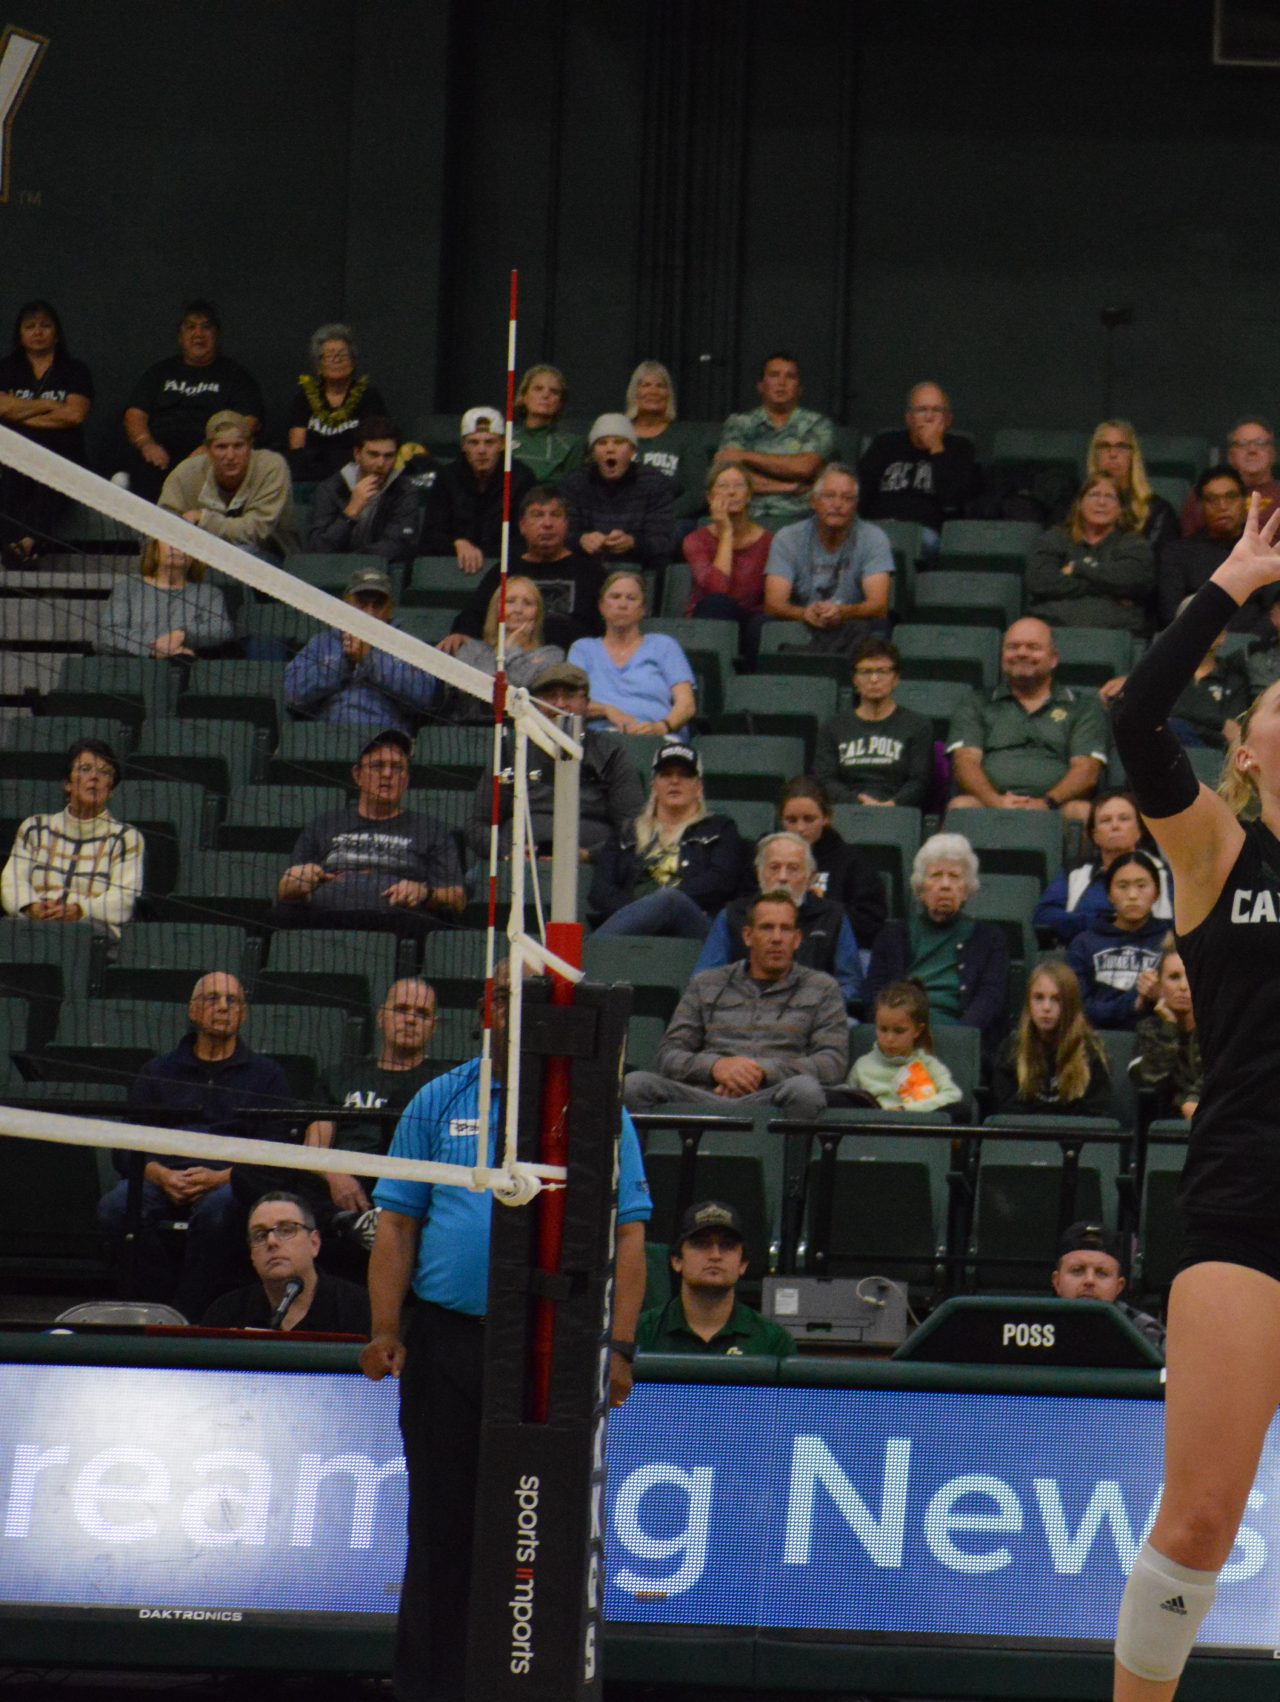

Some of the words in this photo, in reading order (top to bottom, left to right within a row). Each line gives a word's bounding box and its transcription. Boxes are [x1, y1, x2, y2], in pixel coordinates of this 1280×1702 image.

[643, 452, 679, 471] POLY
[868, 736, 903, 761] POLY
[1003, 1323, 1055, 1347] POSS
[516, 1475, 540, 1562] sports
[139, 1609, 242, 1622] DAKTRONICS
[510, 1567, 536, 1675] imports
